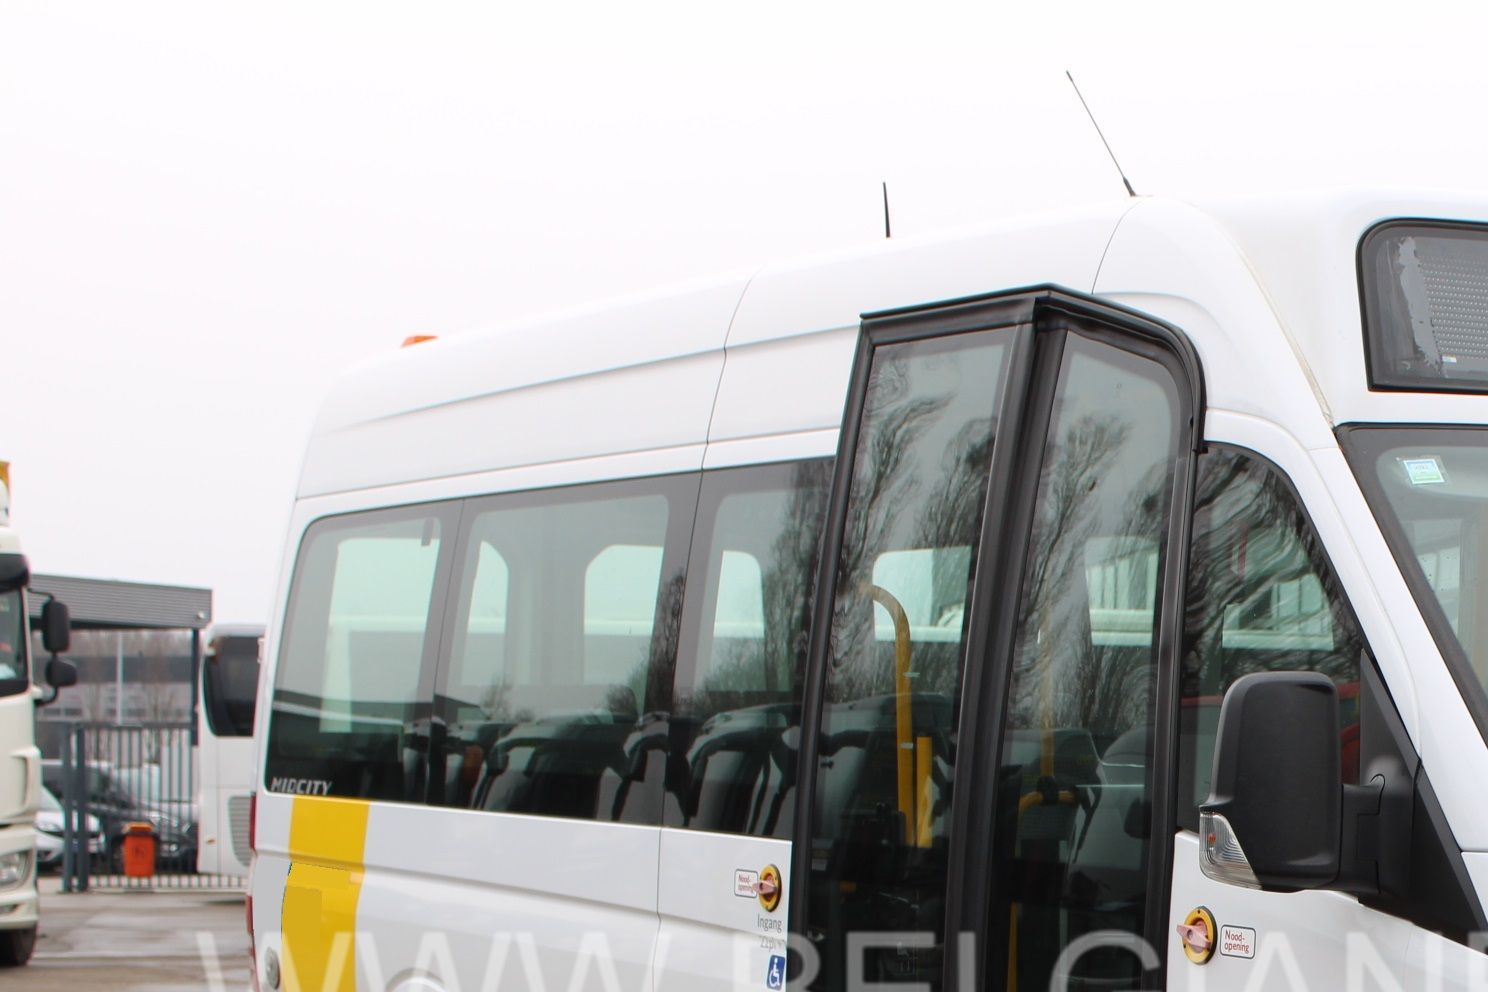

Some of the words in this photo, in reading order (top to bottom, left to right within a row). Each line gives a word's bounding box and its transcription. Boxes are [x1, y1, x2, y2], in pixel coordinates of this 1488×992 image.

[270, 776, 333, 796] MIDCITY
[757, 913, 782, 934] Ingang
[1224, 930, 1245, 943] Nood-
[1224, 942, 1250, 954] opening
